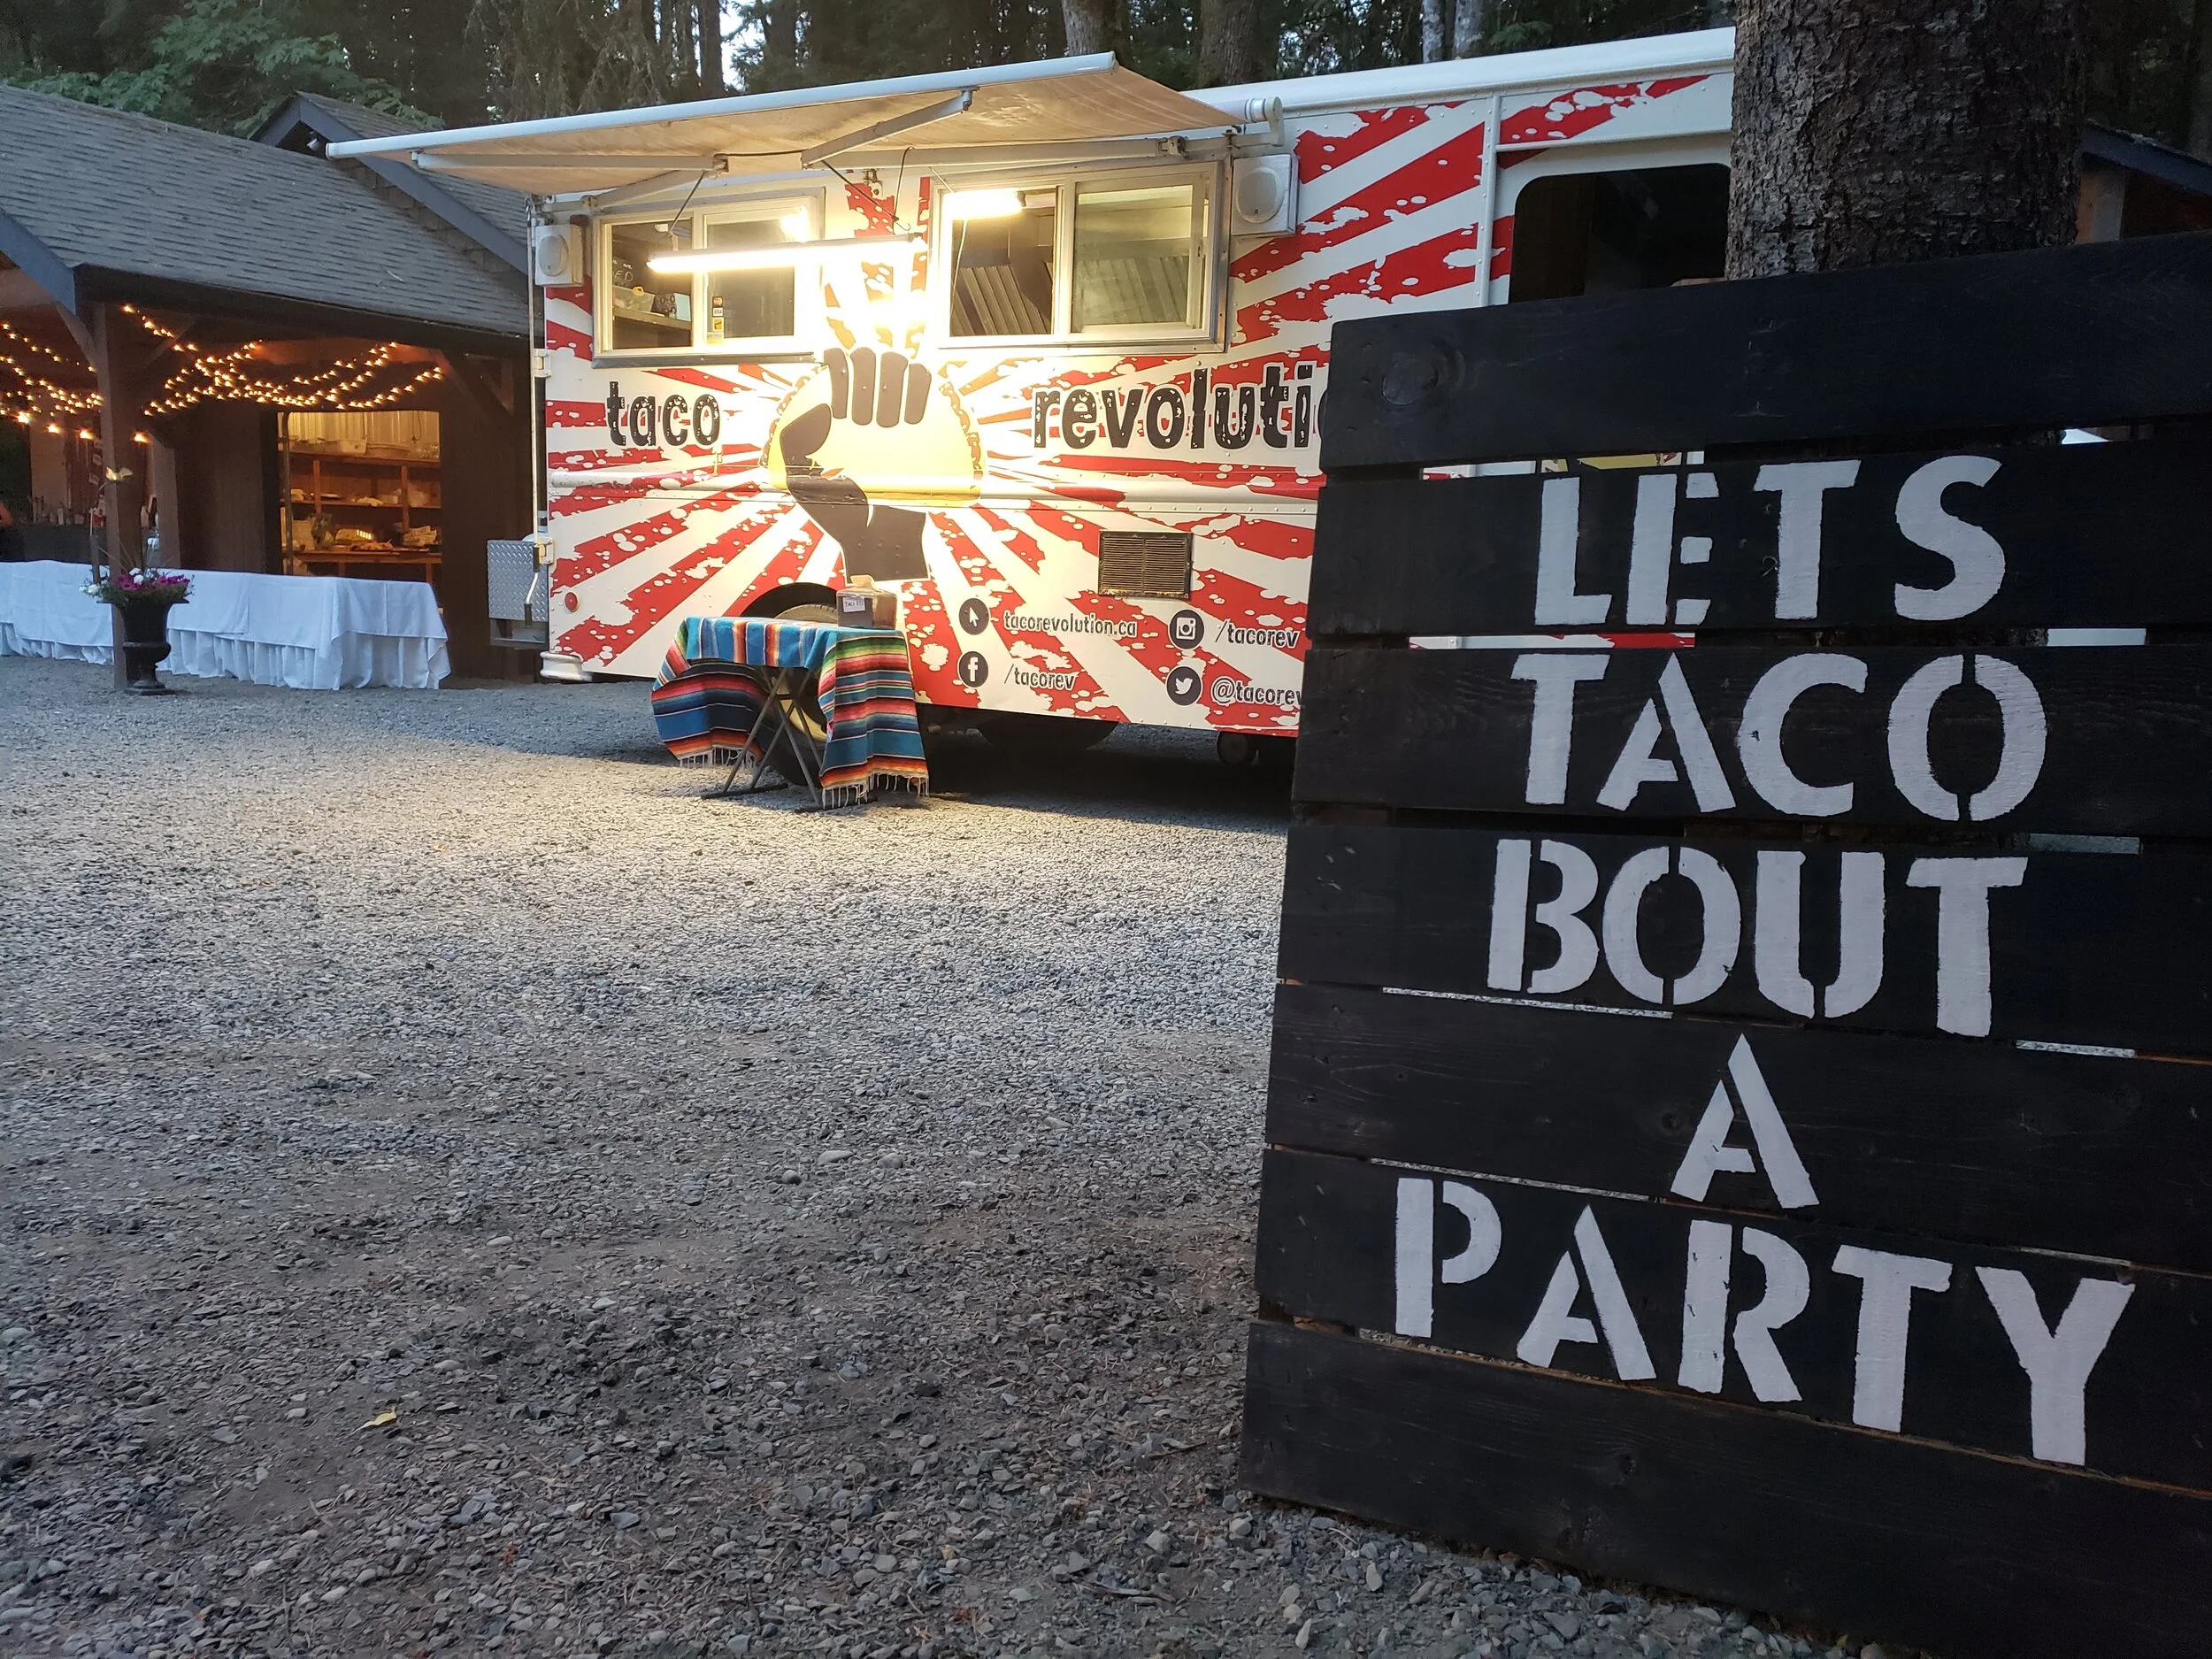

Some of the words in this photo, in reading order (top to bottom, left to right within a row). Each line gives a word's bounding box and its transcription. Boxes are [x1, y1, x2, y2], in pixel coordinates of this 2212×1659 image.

[605, 380, 721, 447] taco
[1033, 365, 1326, 449] revoluti
[1533, 454, 2006, 627] LETS
[1003, 612, 1137, 639] tacorevolution.ca
[1003, 664, 1077, 691] /tacorev
[1214, 619, 1301, 649] /tacorev
[1510, 652, 2047, 823] TACO
[1487, 838, 2029, 1038] BOUT
[1670, 1033, 1820, 1210] A
[1394, 1177, 2136, 1467] PARTY
